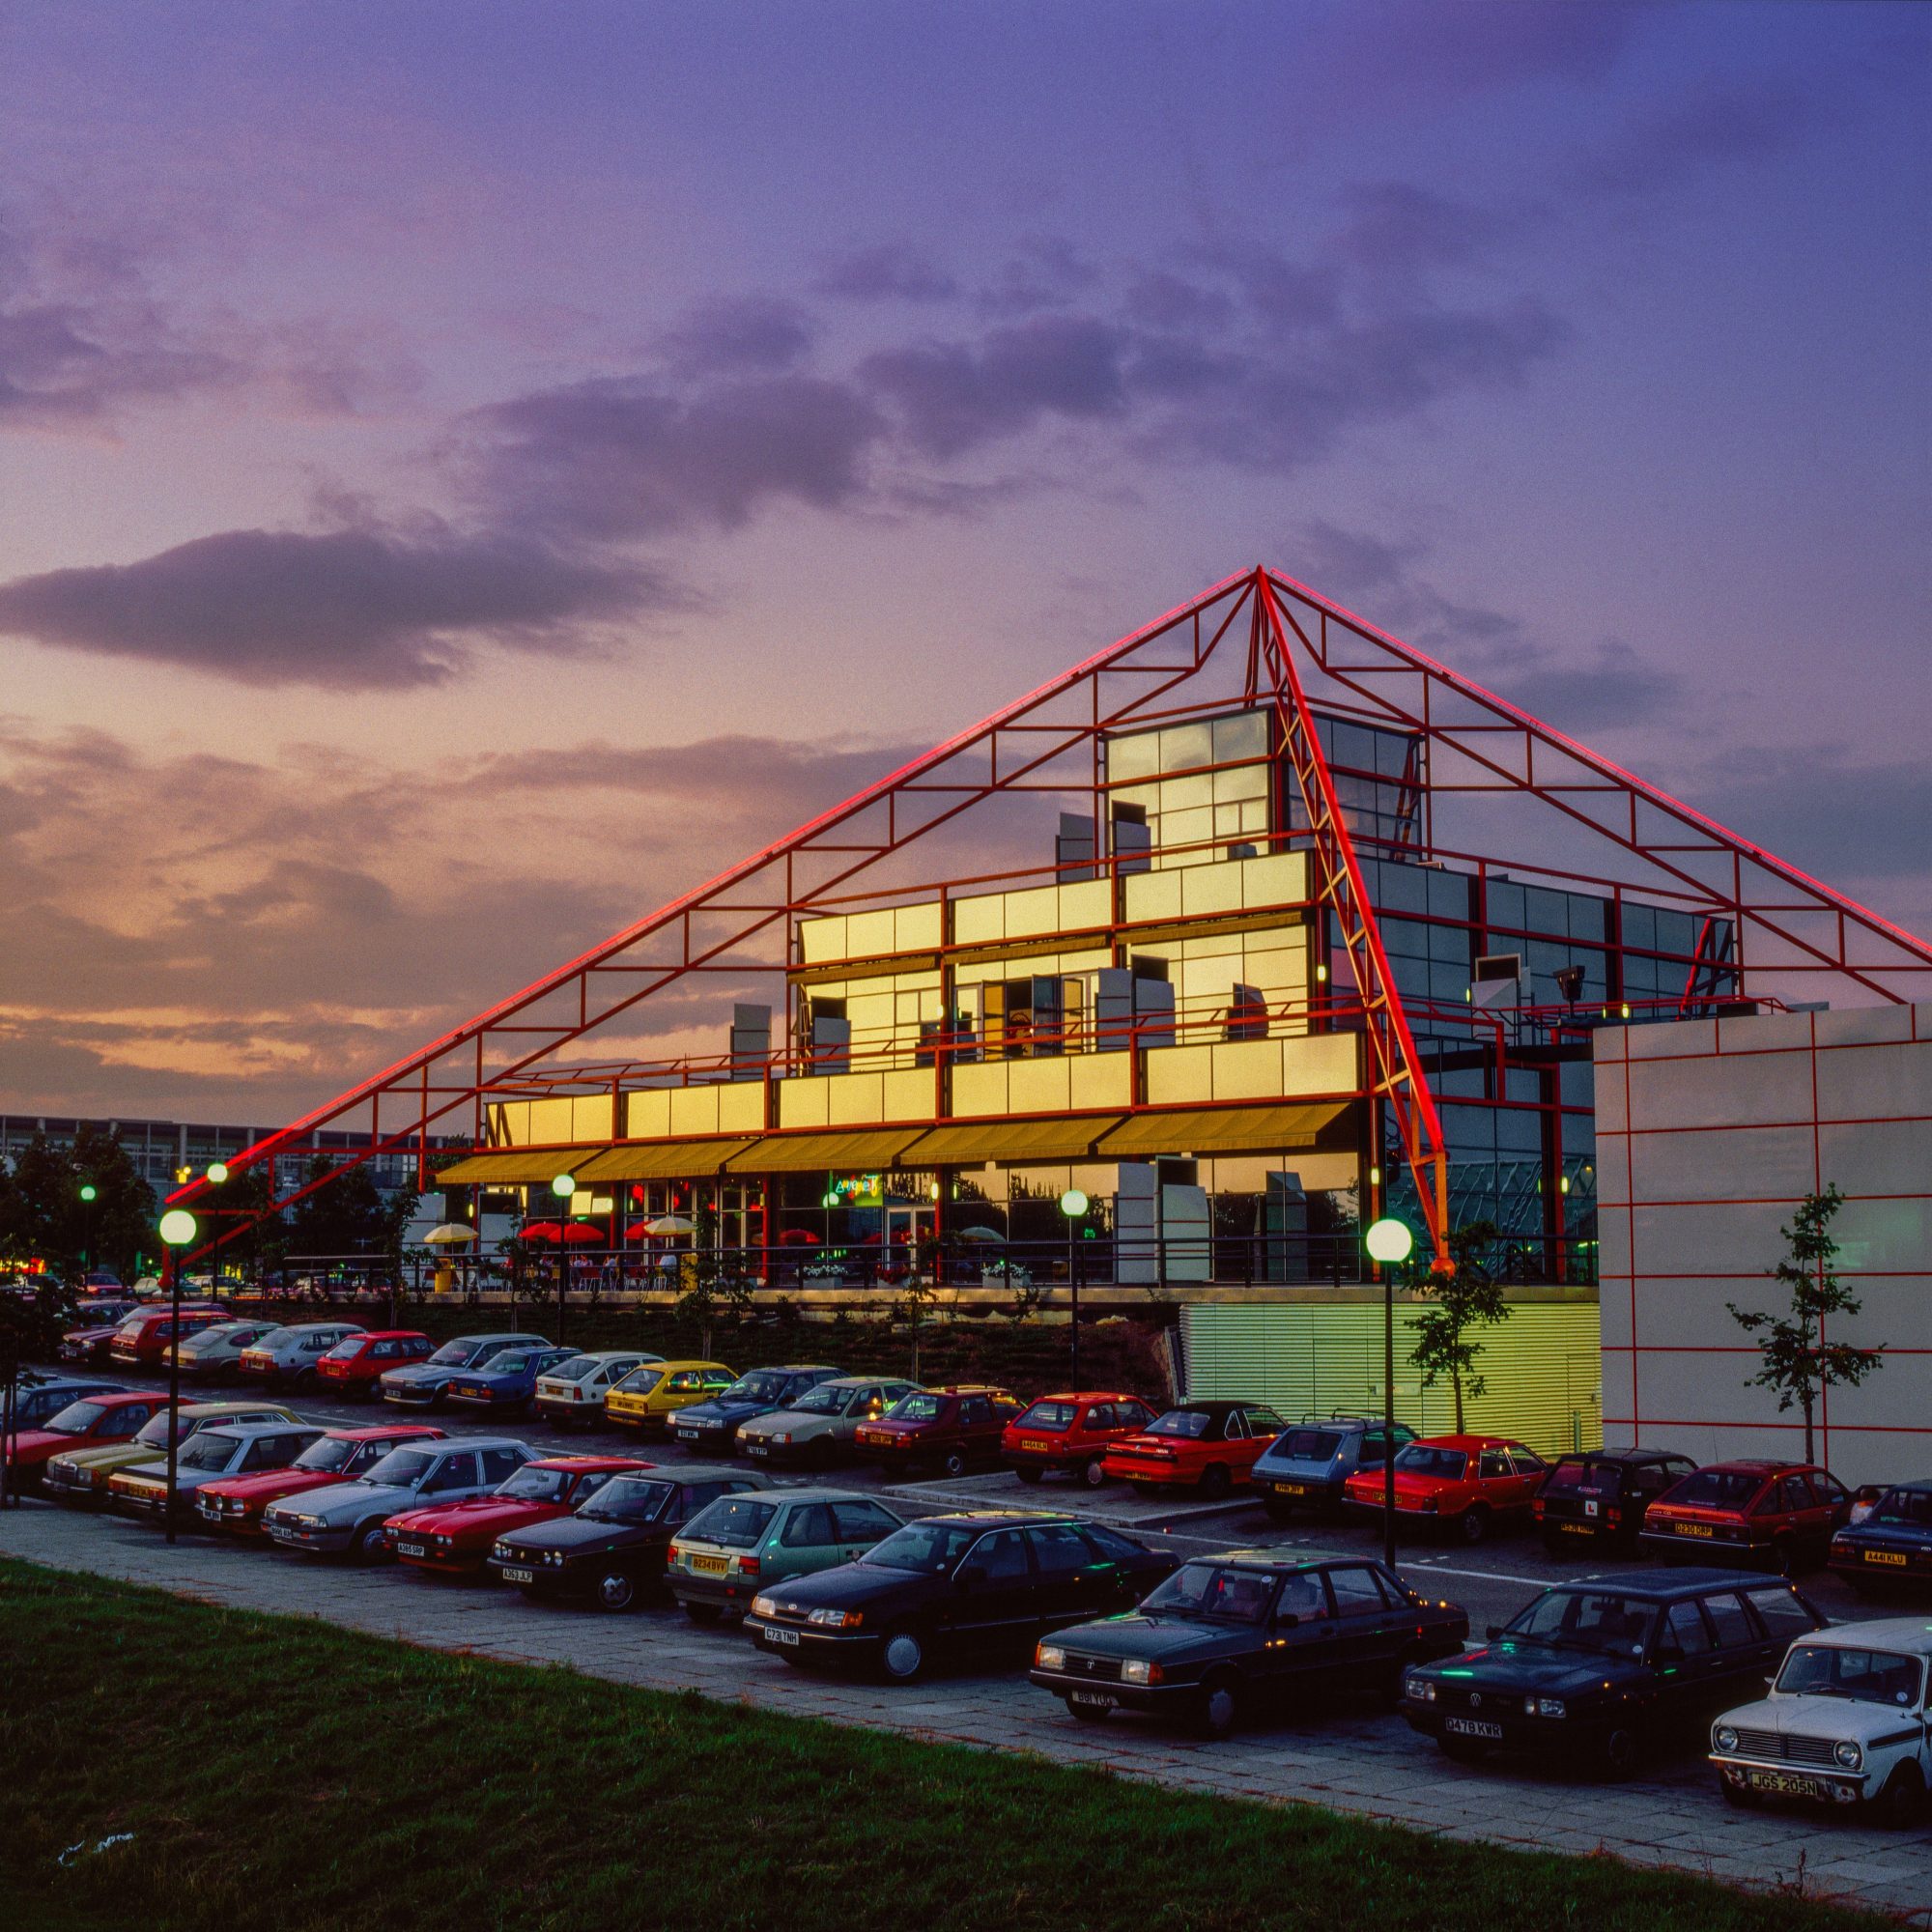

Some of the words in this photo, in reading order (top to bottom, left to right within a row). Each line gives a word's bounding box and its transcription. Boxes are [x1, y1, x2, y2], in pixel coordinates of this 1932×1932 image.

[694, 1558, 710, 1570] B234
[1867, 1550, 1886, 1562] A441
[1887, 1552, 1903, 1564] KLU
[782, 1631, 797, 1643] TNH
[1478, 1722, 1500, 1737] KWR
[1753, 1774, 1779, 1789] JGS
[1781, 1777, 1816, 1795] 205N
